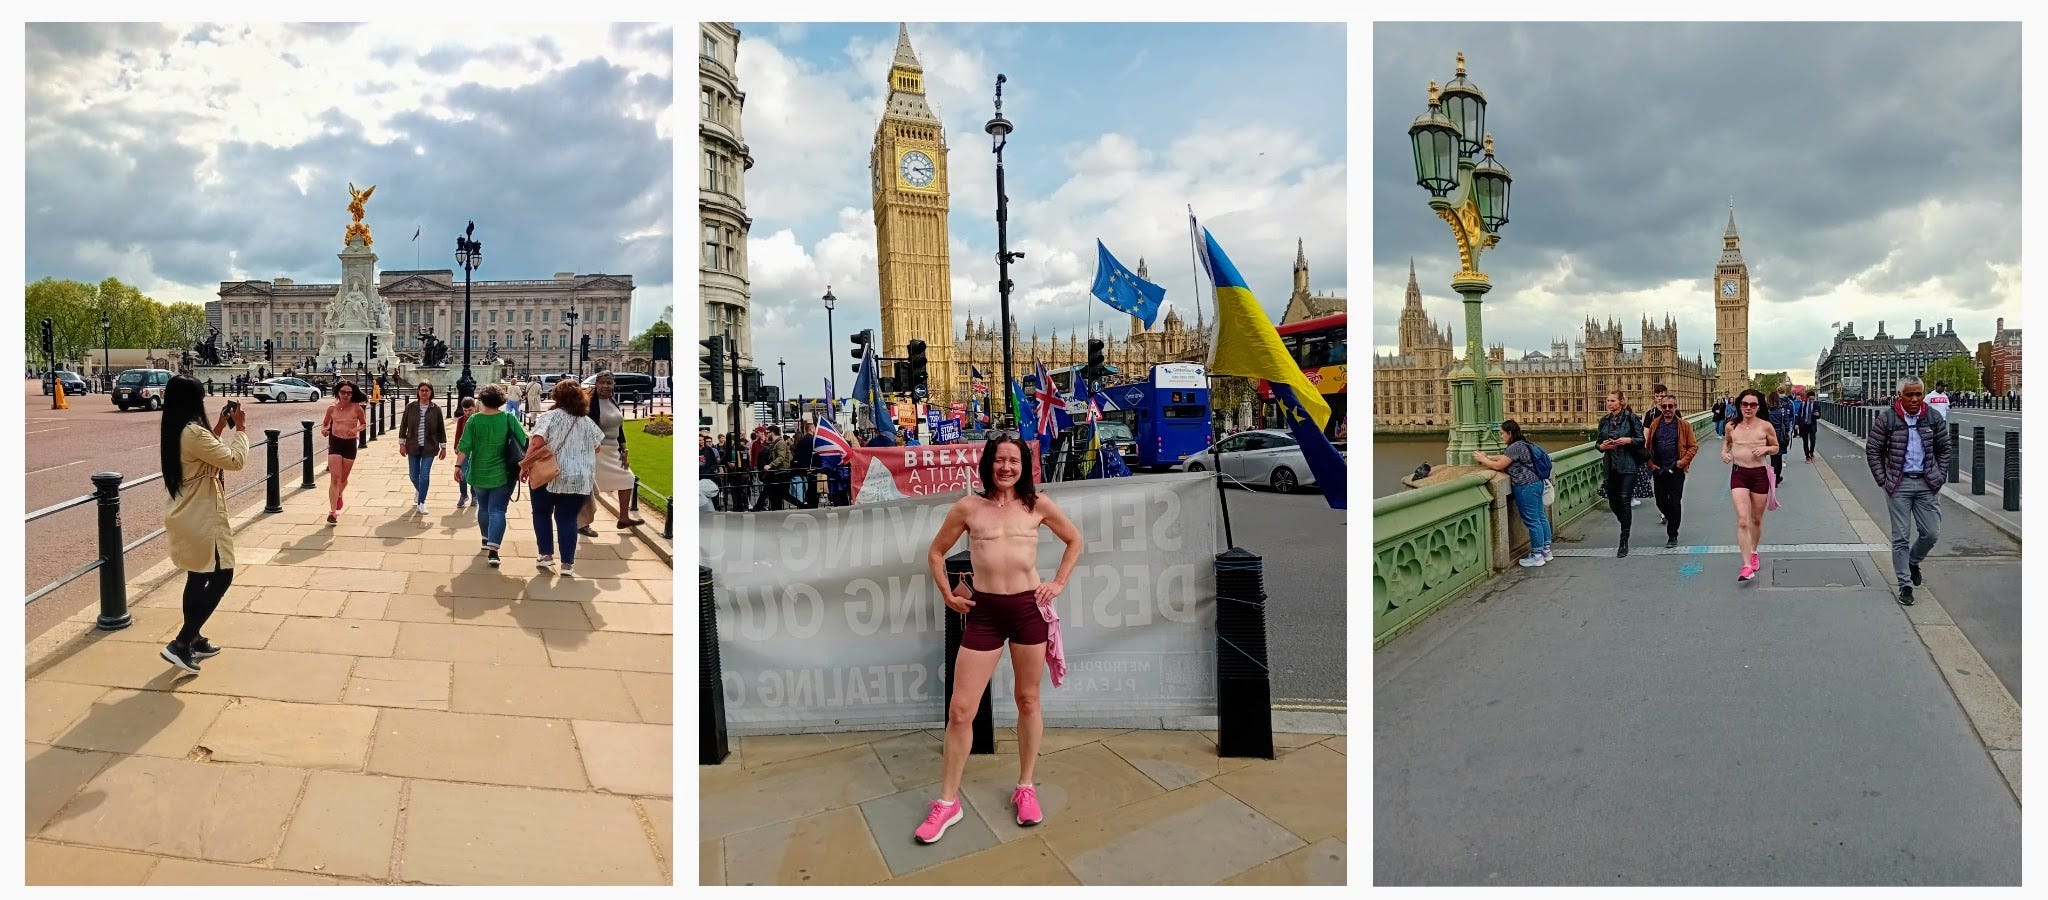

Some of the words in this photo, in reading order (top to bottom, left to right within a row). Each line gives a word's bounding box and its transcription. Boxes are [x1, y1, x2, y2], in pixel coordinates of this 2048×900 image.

[940, 425, 954, 434] STOP
[941, 431, 960, 441] TORIES
[904, 448, 985, 467] BREXI
[909, 469, 921, 483] A
[926, 465, 980, 482] TITAN
